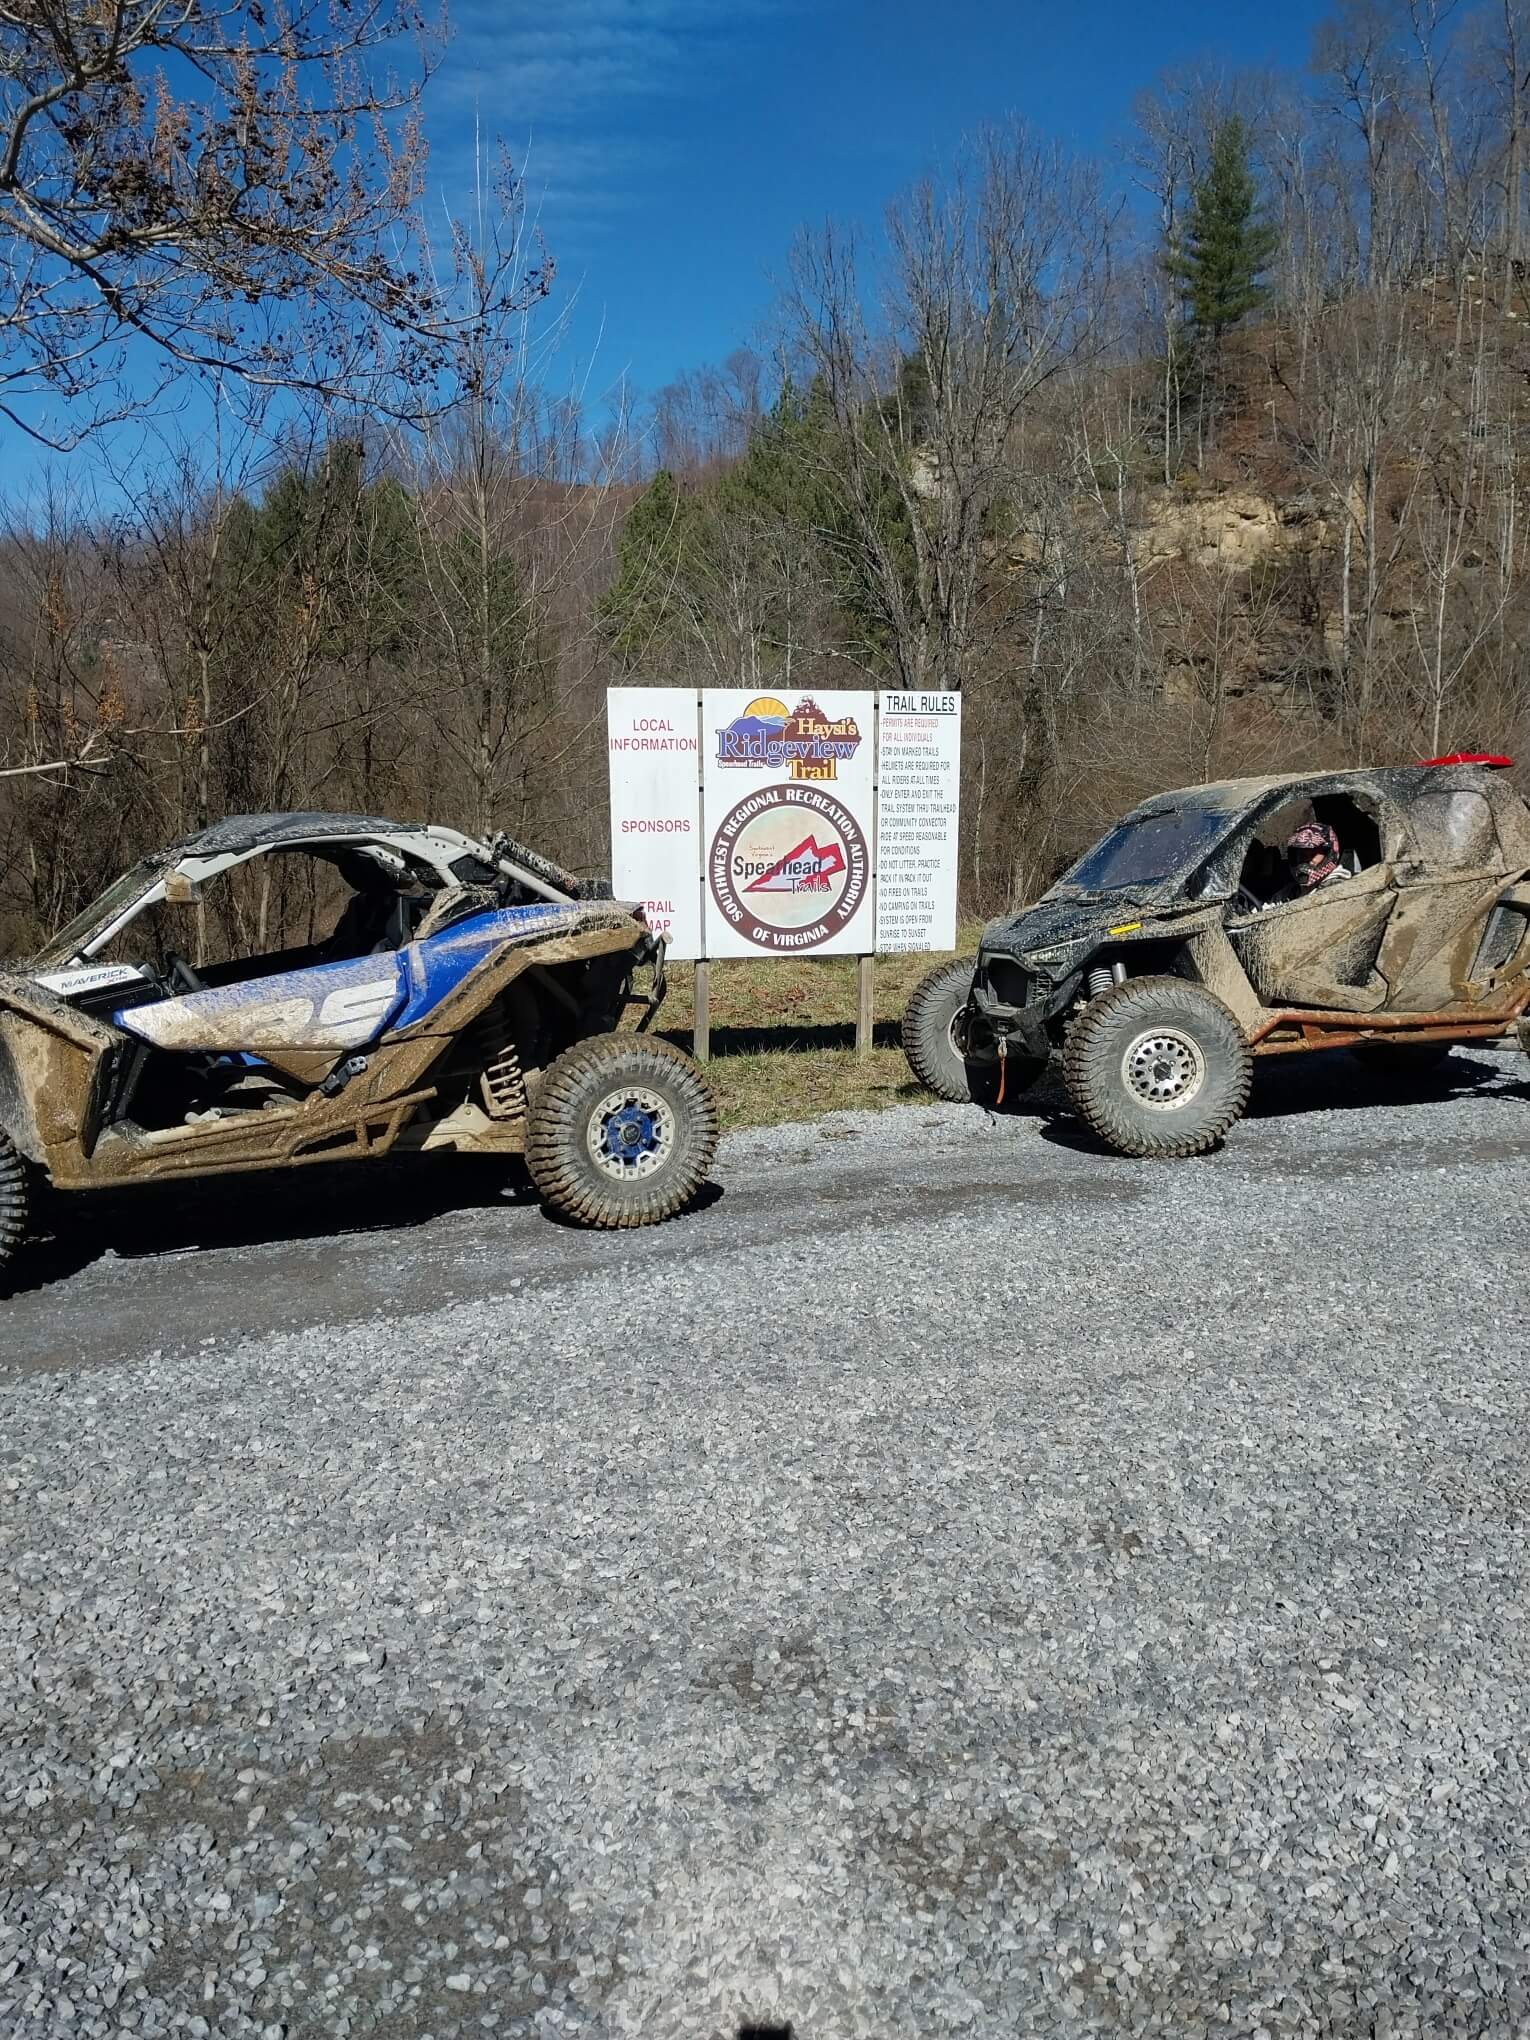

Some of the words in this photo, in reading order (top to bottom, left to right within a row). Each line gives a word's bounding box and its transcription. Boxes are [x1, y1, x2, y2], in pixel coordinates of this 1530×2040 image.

[886, 695, 917, 711] TRAIL
[921, 696, 955, 712] RULES
[633, 718, 675, 732] LOCAL
[797, 717, 857, 740] Haysi's
[610, 738, 697, 751] INFORMATION
[715, 728, 859, 768] Ridgeview
[785, 758, 838, 780] Trail
[905, 761, 914, 770] ARE
[941, 761, 950, 770] FOR
[934, 790, 943, 799] THE
[724, 790, 783, 838] REGIONAL
[786, 788, 857, 841] RECREATION
[621, 820, 691, 833] SPONSORS
[733, 855, 822, 879] Spearhead
[714, 837, 743, 922] SOUTHWEST
[786, 875, 829, 895] Trails
[837, 843, 864, 920] AUTHORITY
[752, 926, 771, 942] OF
[773, 924, 829, 946] VIRGINIA
[61, 967, 128, 989] MAVERICK
